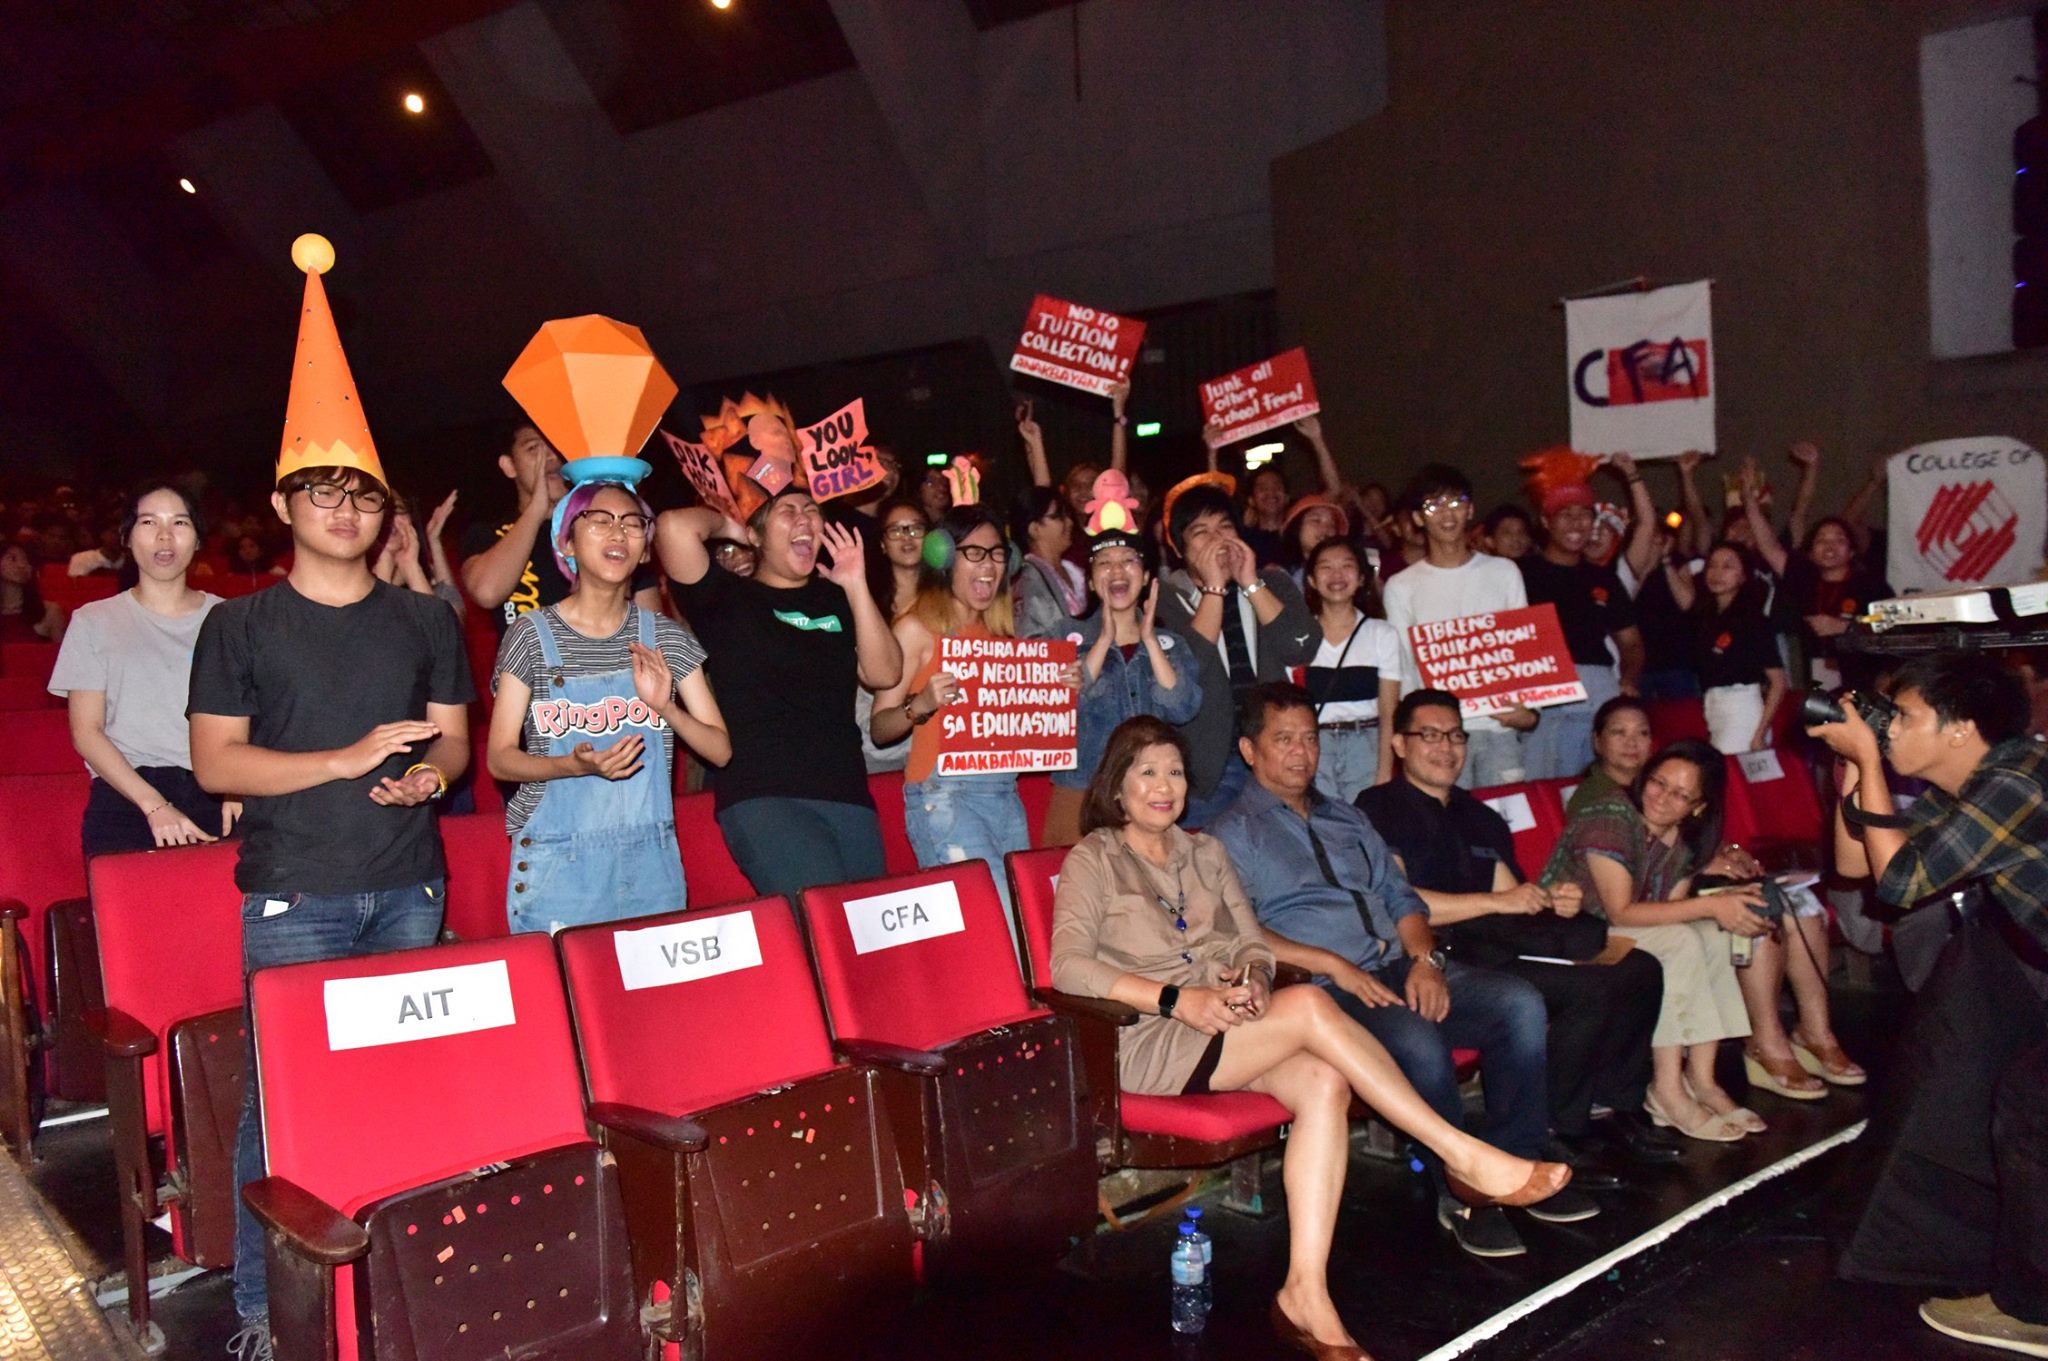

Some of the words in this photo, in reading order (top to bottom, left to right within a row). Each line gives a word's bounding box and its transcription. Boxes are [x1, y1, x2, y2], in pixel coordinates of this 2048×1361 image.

[1038, 311, 1118, 352] TUITION
[1067, 303, 1095, 322] NO
[1097, 312, 1119, 331] TO
[1020, 330, 1129, 379] COLLECTION!
[1205, 373, 1244, 403] Junk
[1251, 360, 1273, 383] all
[1574, 335, 1700, 409] CFA
[1214, 387, 1258, 412] other
[807, 411, 854, 453] YOU
[810, 440, 872, 472] LOOK,
[1906, 451, 1999, 475] COLLEGE
[2007, 448, 2033, 466] OF
[813, 460, 874, 496] GIRL
[1412, 613, 1497, 644] LIBRENG
[1417, 622, 1538, 663] EDUKASYON!
[941, 637, 1014, 659] IBASURA
[1015, 641, 1049, 658] ANG
[1426, 647, 1516, 677] WALANG
[982, 661, 1068, 685] NEOLIBER
[1432, 655, 1559, 692] KOLEKSYON!
[977, 686, 1071, 708] PATAKARAN
[942, 713, 967, 739] SA
[970, 708, 1077, 739] EDUKASYON!
[881, 902, 930, 932] CFA
[660, 935, 722, 969] VSB
[398, 987, 454, 1024] AIT
